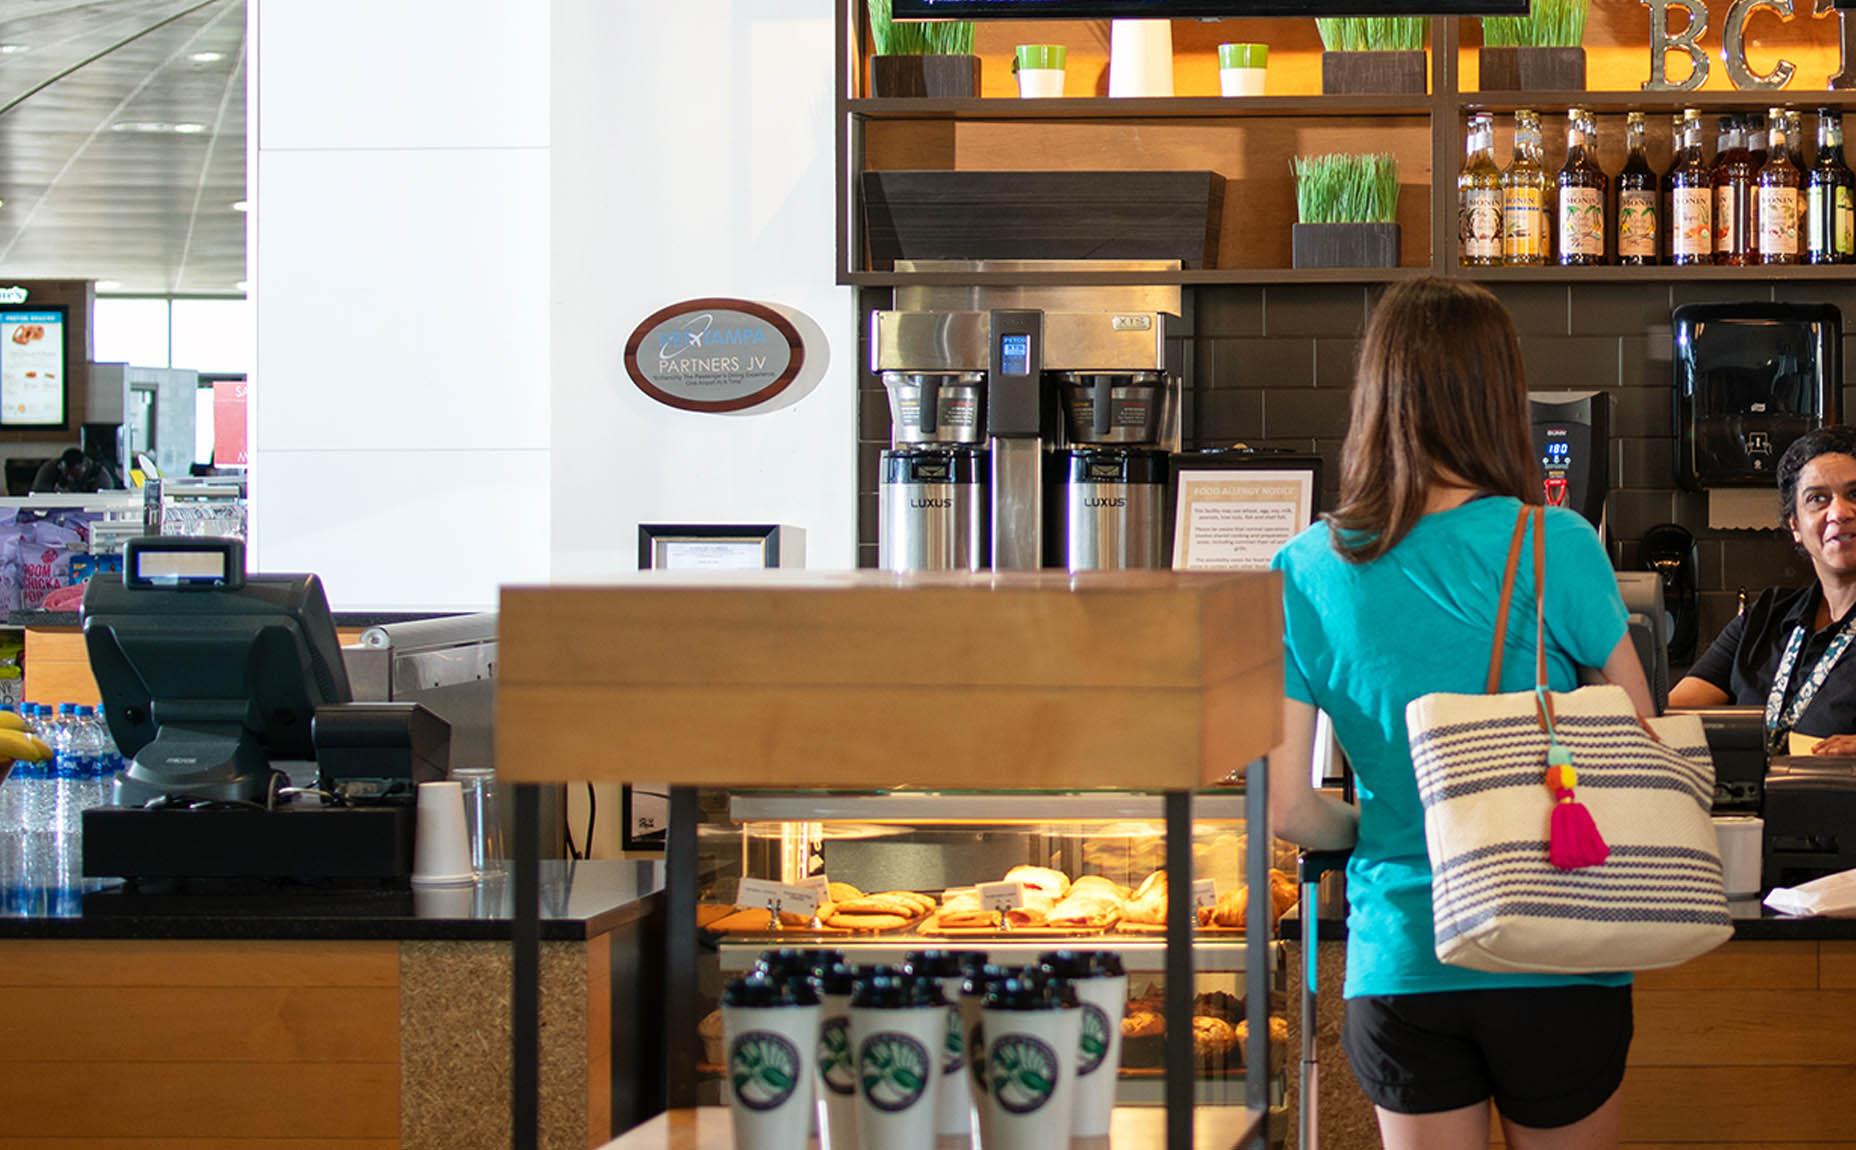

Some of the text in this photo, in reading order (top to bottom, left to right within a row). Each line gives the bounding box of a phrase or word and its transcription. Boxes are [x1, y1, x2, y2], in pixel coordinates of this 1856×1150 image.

[1119, 316, 1146, 328] XTS
[659, 356, 767, 374] PARTNERS JV
[1549, 443, 1568, 454] 180
[910, 497, 952, 508] LUXUS
[1084, 497, 1126, 508] LUXUS
